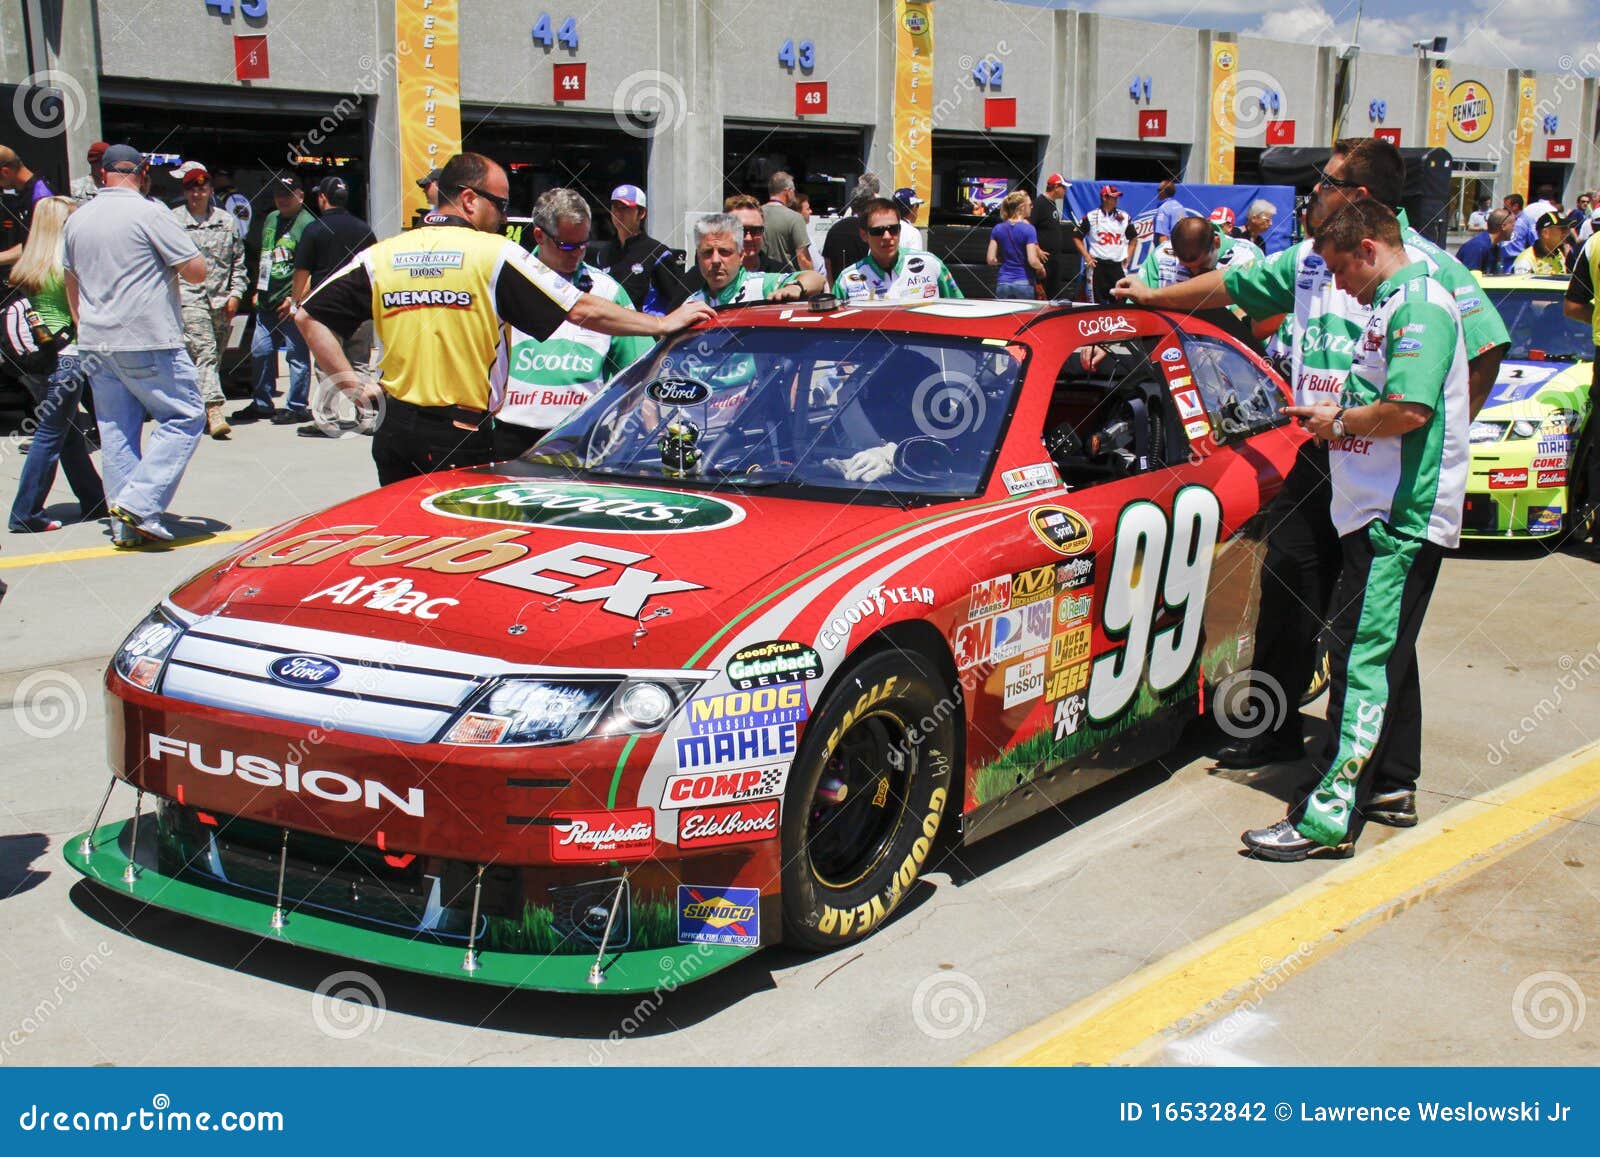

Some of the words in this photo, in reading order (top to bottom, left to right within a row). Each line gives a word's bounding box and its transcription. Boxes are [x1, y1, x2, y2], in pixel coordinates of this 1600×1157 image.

[531, 12, 578, 49] 44
[778, 39, 815, 69] 43
[561, 75, 580, 90] 44
[973, 57, 1004, 88] 42
[804, 91, 821, 104] 43
[1129, 74, 1152, 102] 41
[1369, 98, 1387, 122] 39
[1452, 98, 1488, 122] PENNZOIL
[1144, 118, 1160, 130] 41
[506, 225, 521, 244] 24
[1096, 231, 1122, 246] 3M
[393, 252, 460, 265] MASTRCRAFT
[515, 347, 593, 373] Scotts
[508, 391, 538, 405] Turf
[540, 390, 588, 406] Build
[660, 381, 697, 399] Ford
[1533, 457, 1563, 468] COMP
[460, 487, 699, 522] Scotts
[1054, 523, 1074, 540] Sprint
[970, 578, 1011, 611] Holley
[1062, 576, 1087, 590] POLE
[301, 576, 460, 620] Aflac
[979, 601, 1003, 616] CARBS
[1088, 484, 1222, 721] 99
[819, 584, 936, 650] GOODYEAR
[736, 641, 800, 660] GOODYEAR
[956, 619, 992, 664] 3M
[1062, 642, 1090, 660] Meter
[1063, 630, 1085, 648] Auto
[280, 657, 333, 682] Ford
[729, 651, 818, 680] Gatorback
[740, 668, 816, 689] BELTS
[1005, 673, 1044, 698] TISSOT
[1046, 664, 1089, 703] JEGS
[692, 684, 801, 723] MOOG
[827, 675, 898, 757] EAGLE
[698, 716, 755, 735] CHASSIS
[763, 709, 801, 725] PARTS
[676, 724, 796, 768] MAHLE
[1311, 698, 1384, 826] Scotts
[148, 732, 425, 818] FUSION
[669, 770, 762, 801] COMP
[732, 785, 774, 799] CAMS
[680, 809, 776, 840] Edelbrock
[598, 842, 616, 850] best
[818, 786, 947, 936] GOODYEAR
[686, 905, 752, 920] SUNOCO
